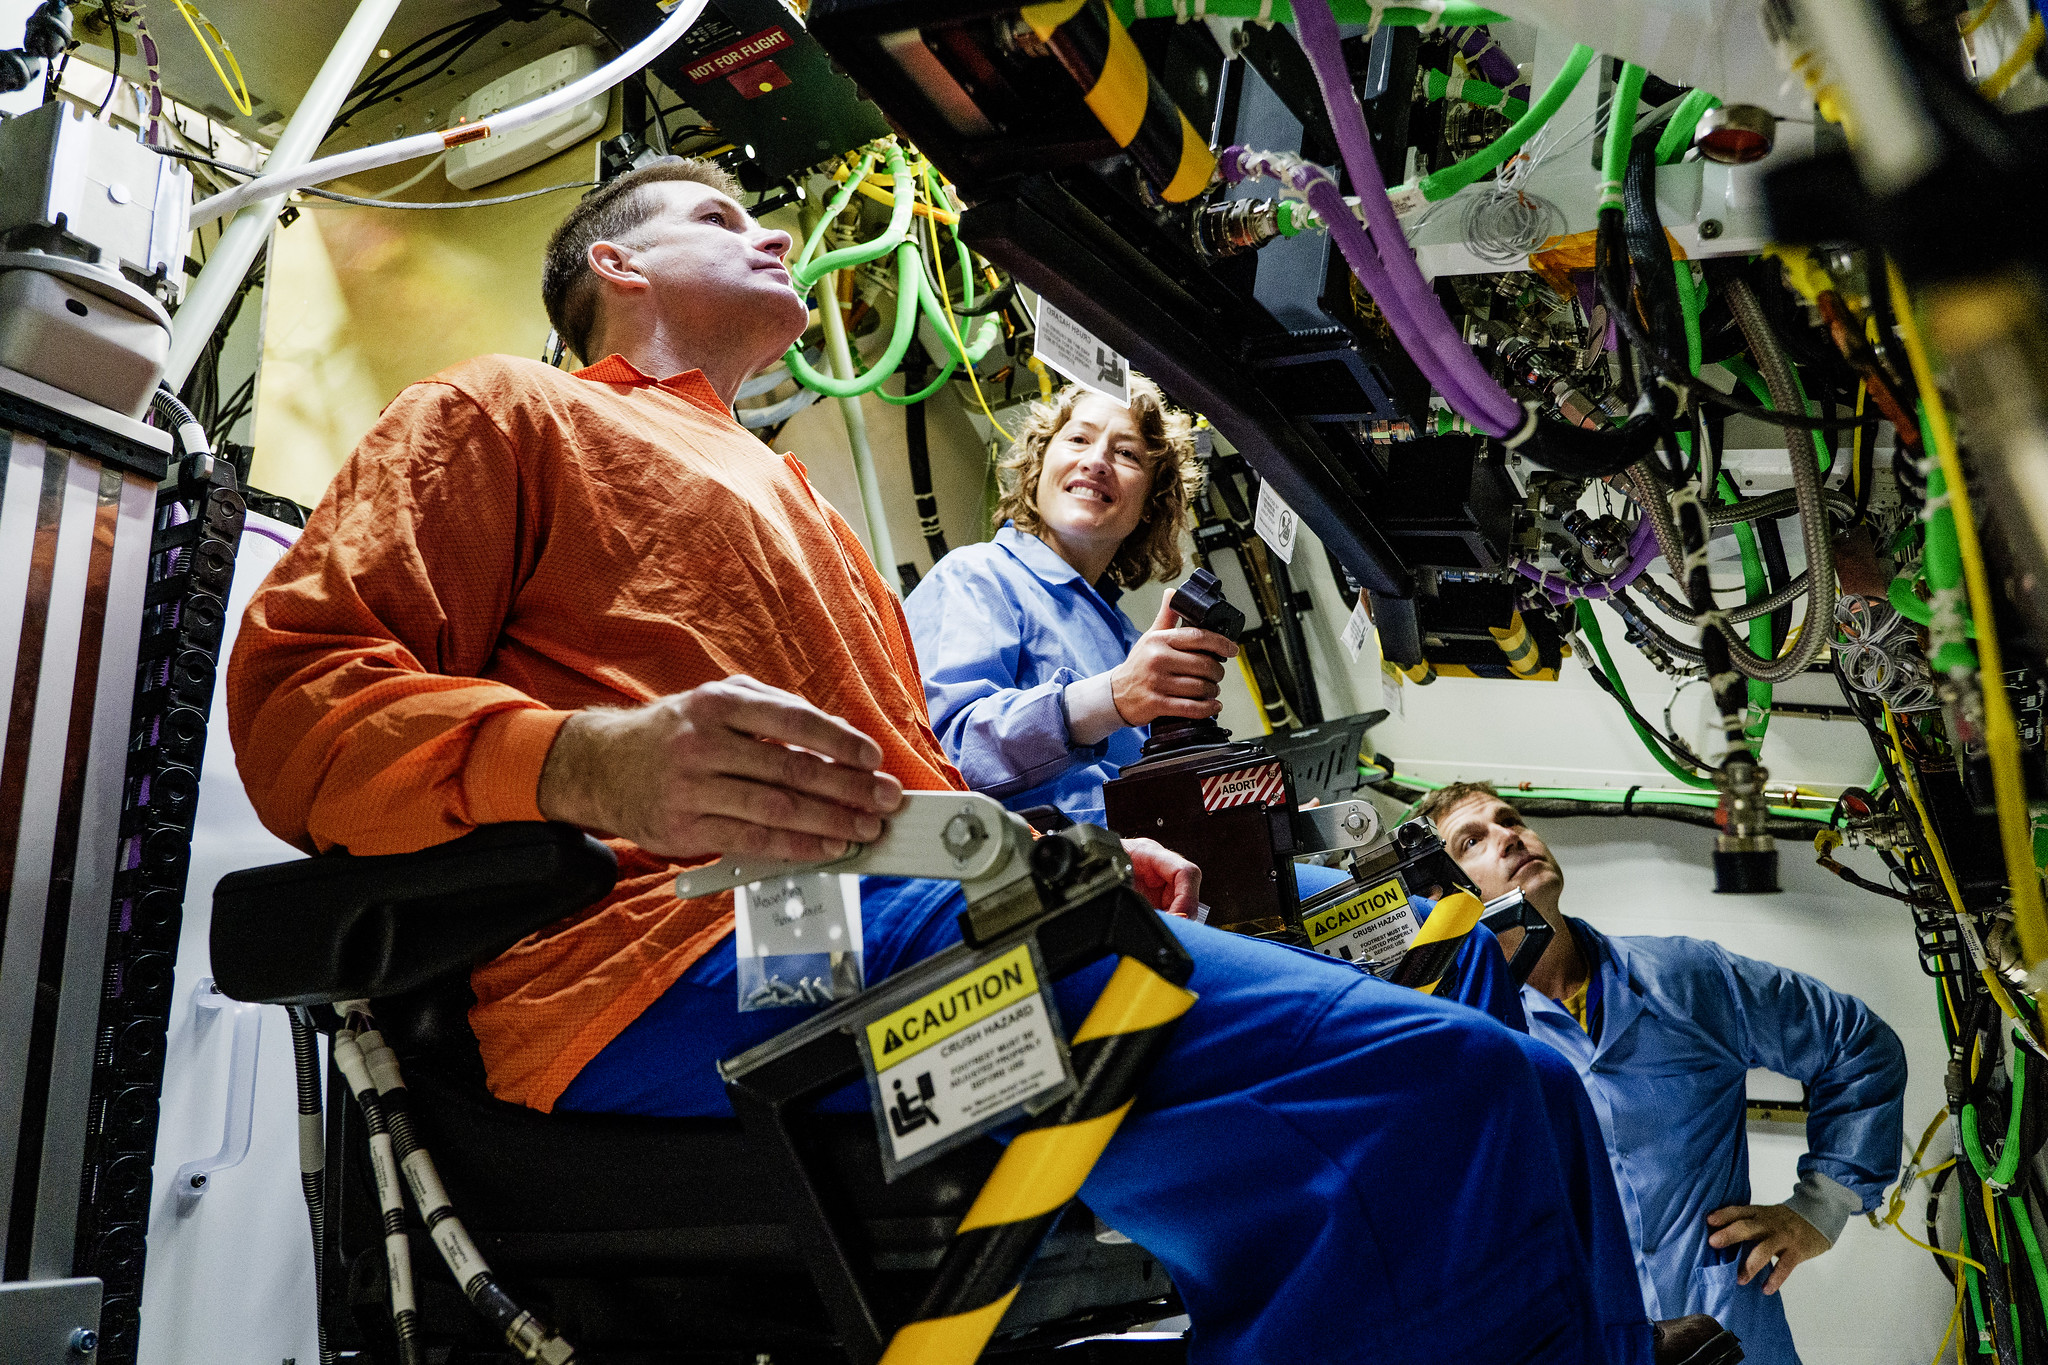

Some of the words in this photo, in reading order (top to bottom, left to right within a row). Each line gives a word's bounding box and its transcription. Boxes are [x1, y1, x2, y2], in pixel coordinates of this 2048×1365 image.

[688, 62, 716, 80] NOT
[714, 51, 743, 69] FOR
[740, 31, 786, 57] FLIGHT
[1222, 779, 1256, 795] ABORT
[1325, 888, 1399, 930] CAUTION
[1352, 923, 1378, 939] CRUSH
[1378, 910, 1407, 928] HAZARD
[1360, 933, 1387, 949] FOOTREST
[1386, 927, 1401, 939] MUST
[1400, 924, 1410, 932] BE
[1386, 928, 1414, 945] PROPERLY
[1373, 944, 1395, 957] BEFORE
[1394, 939, 1406, 948] USE
[902, 961, 1023, 1041] CAUTION
[940, 1030, 982, 1058] CRUSH
[982, 1003, 1034, 1037] HAZARD
